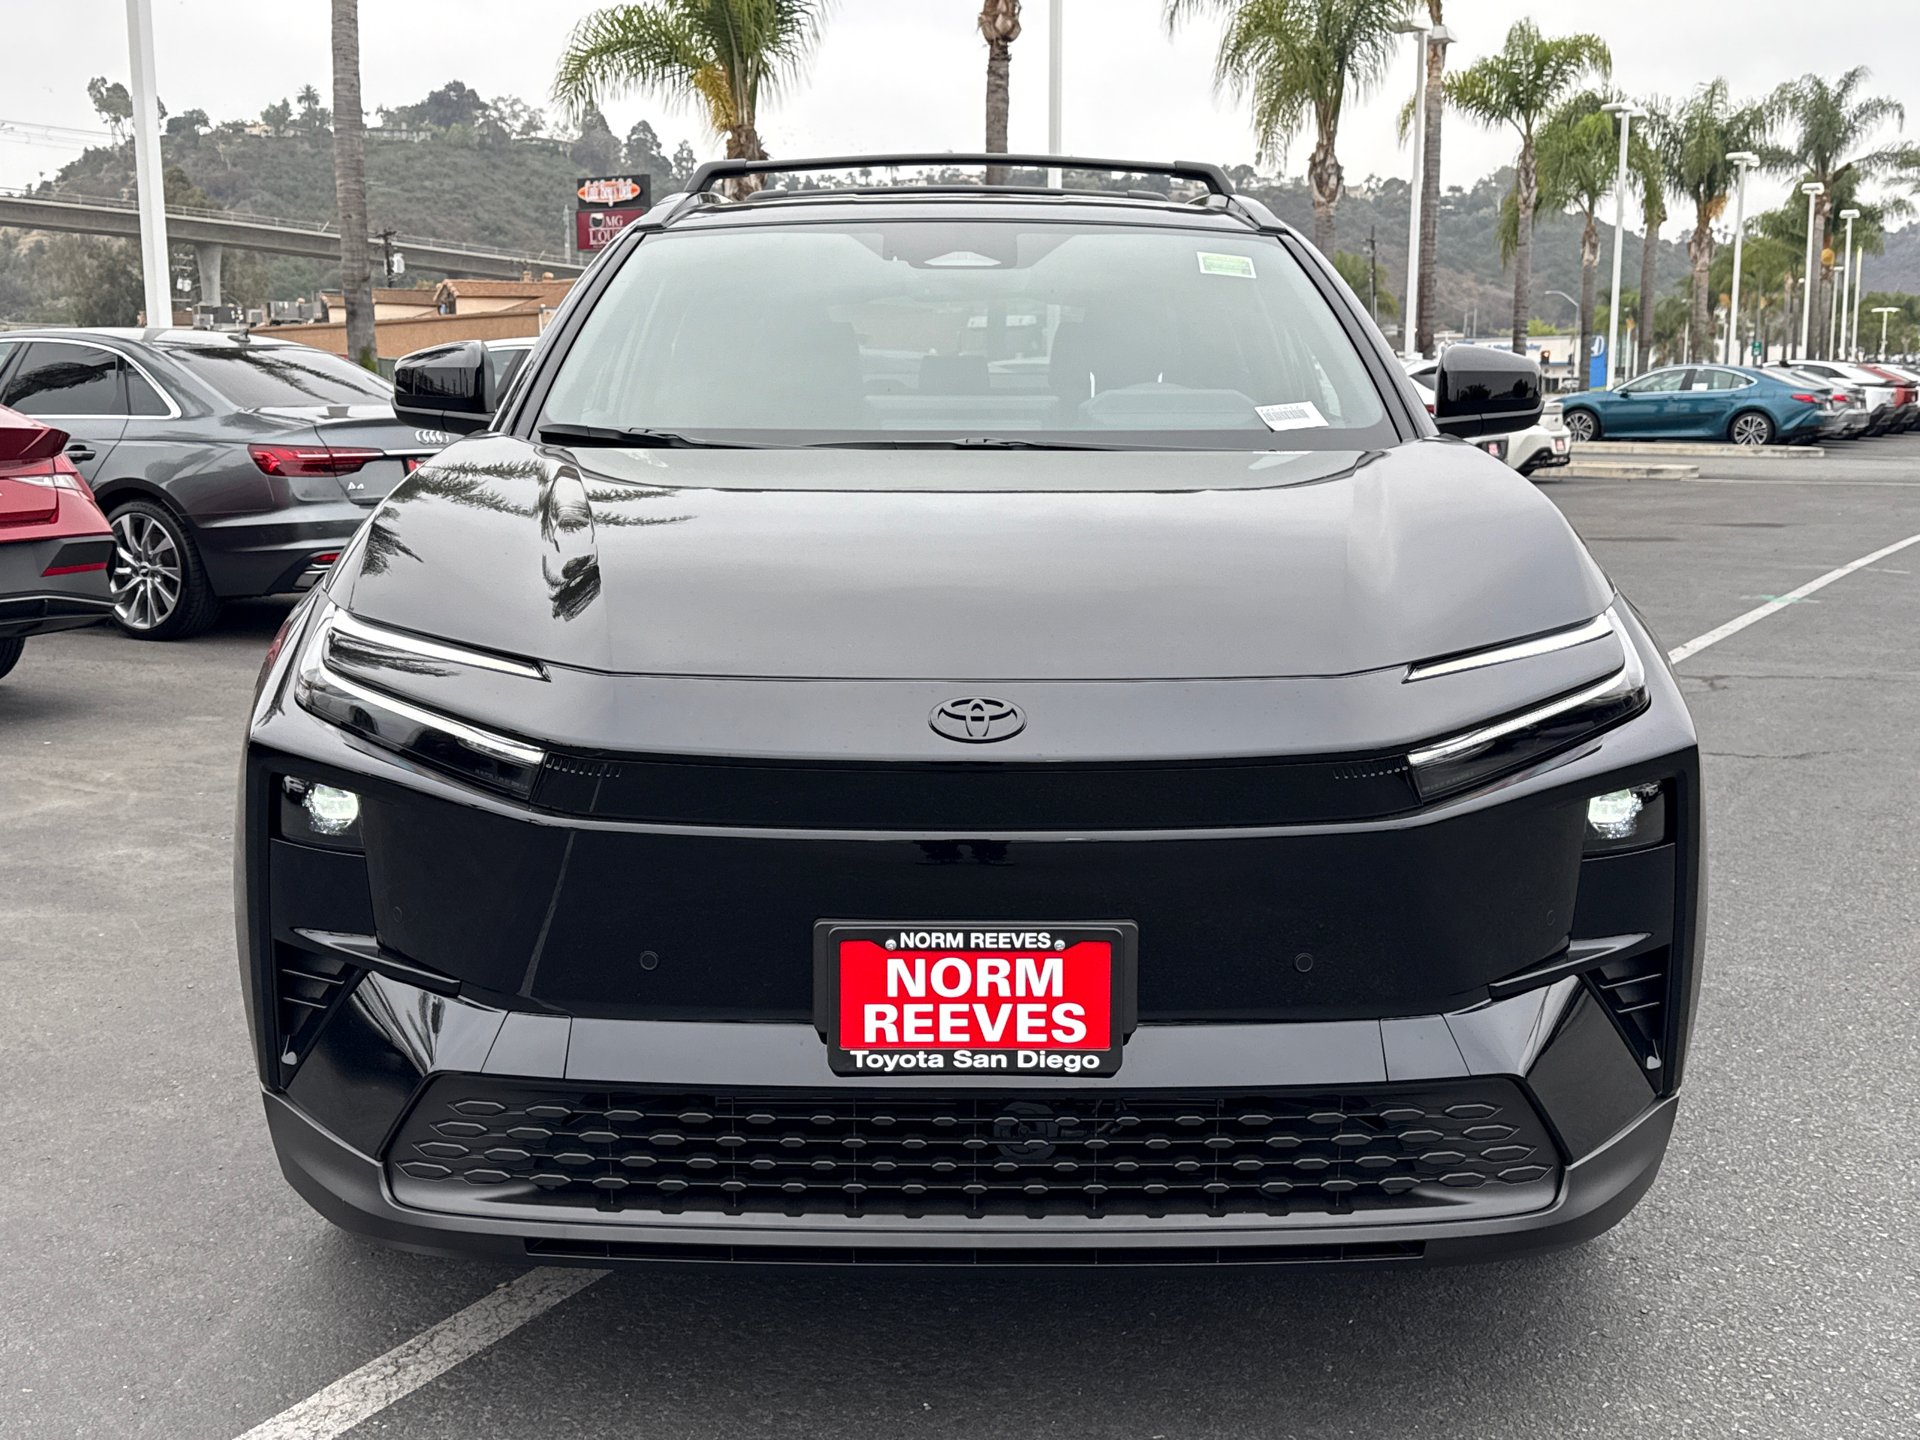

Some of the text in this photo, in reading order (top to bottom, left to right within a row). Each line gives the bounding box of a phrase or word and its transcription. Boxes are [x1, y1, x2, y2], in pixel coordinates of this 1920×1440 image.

[589, 228, 619, 245] LOU
[900, 931, 1052, 949] NORM REEVES
[886, 957, 1064, 998] NORM
[863, 1002, 1087, 1044] REEVES
[849, 1050, 1100, 1073] Toyota San Diego
